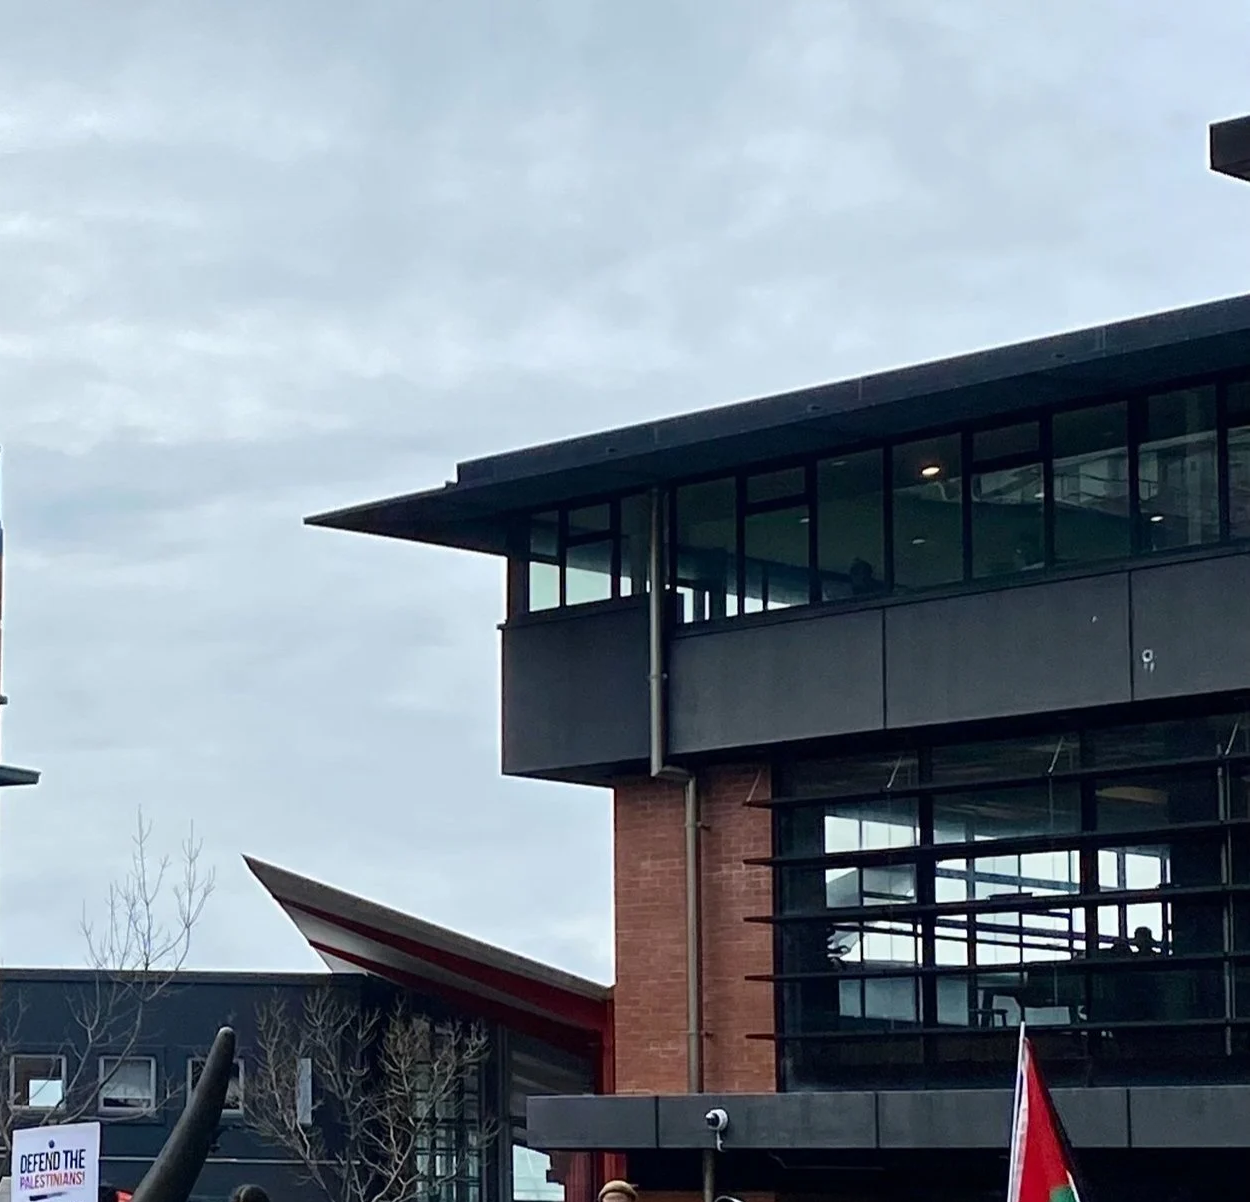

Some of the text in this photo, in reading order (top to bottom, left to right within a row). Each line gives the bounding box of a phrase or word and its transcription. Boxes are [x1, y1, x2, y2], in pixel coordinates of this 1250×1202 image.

[20, 1149, 86, 1174] DEFEND THE
[20, 1171, 85, 1190] PALESTINIANS!
